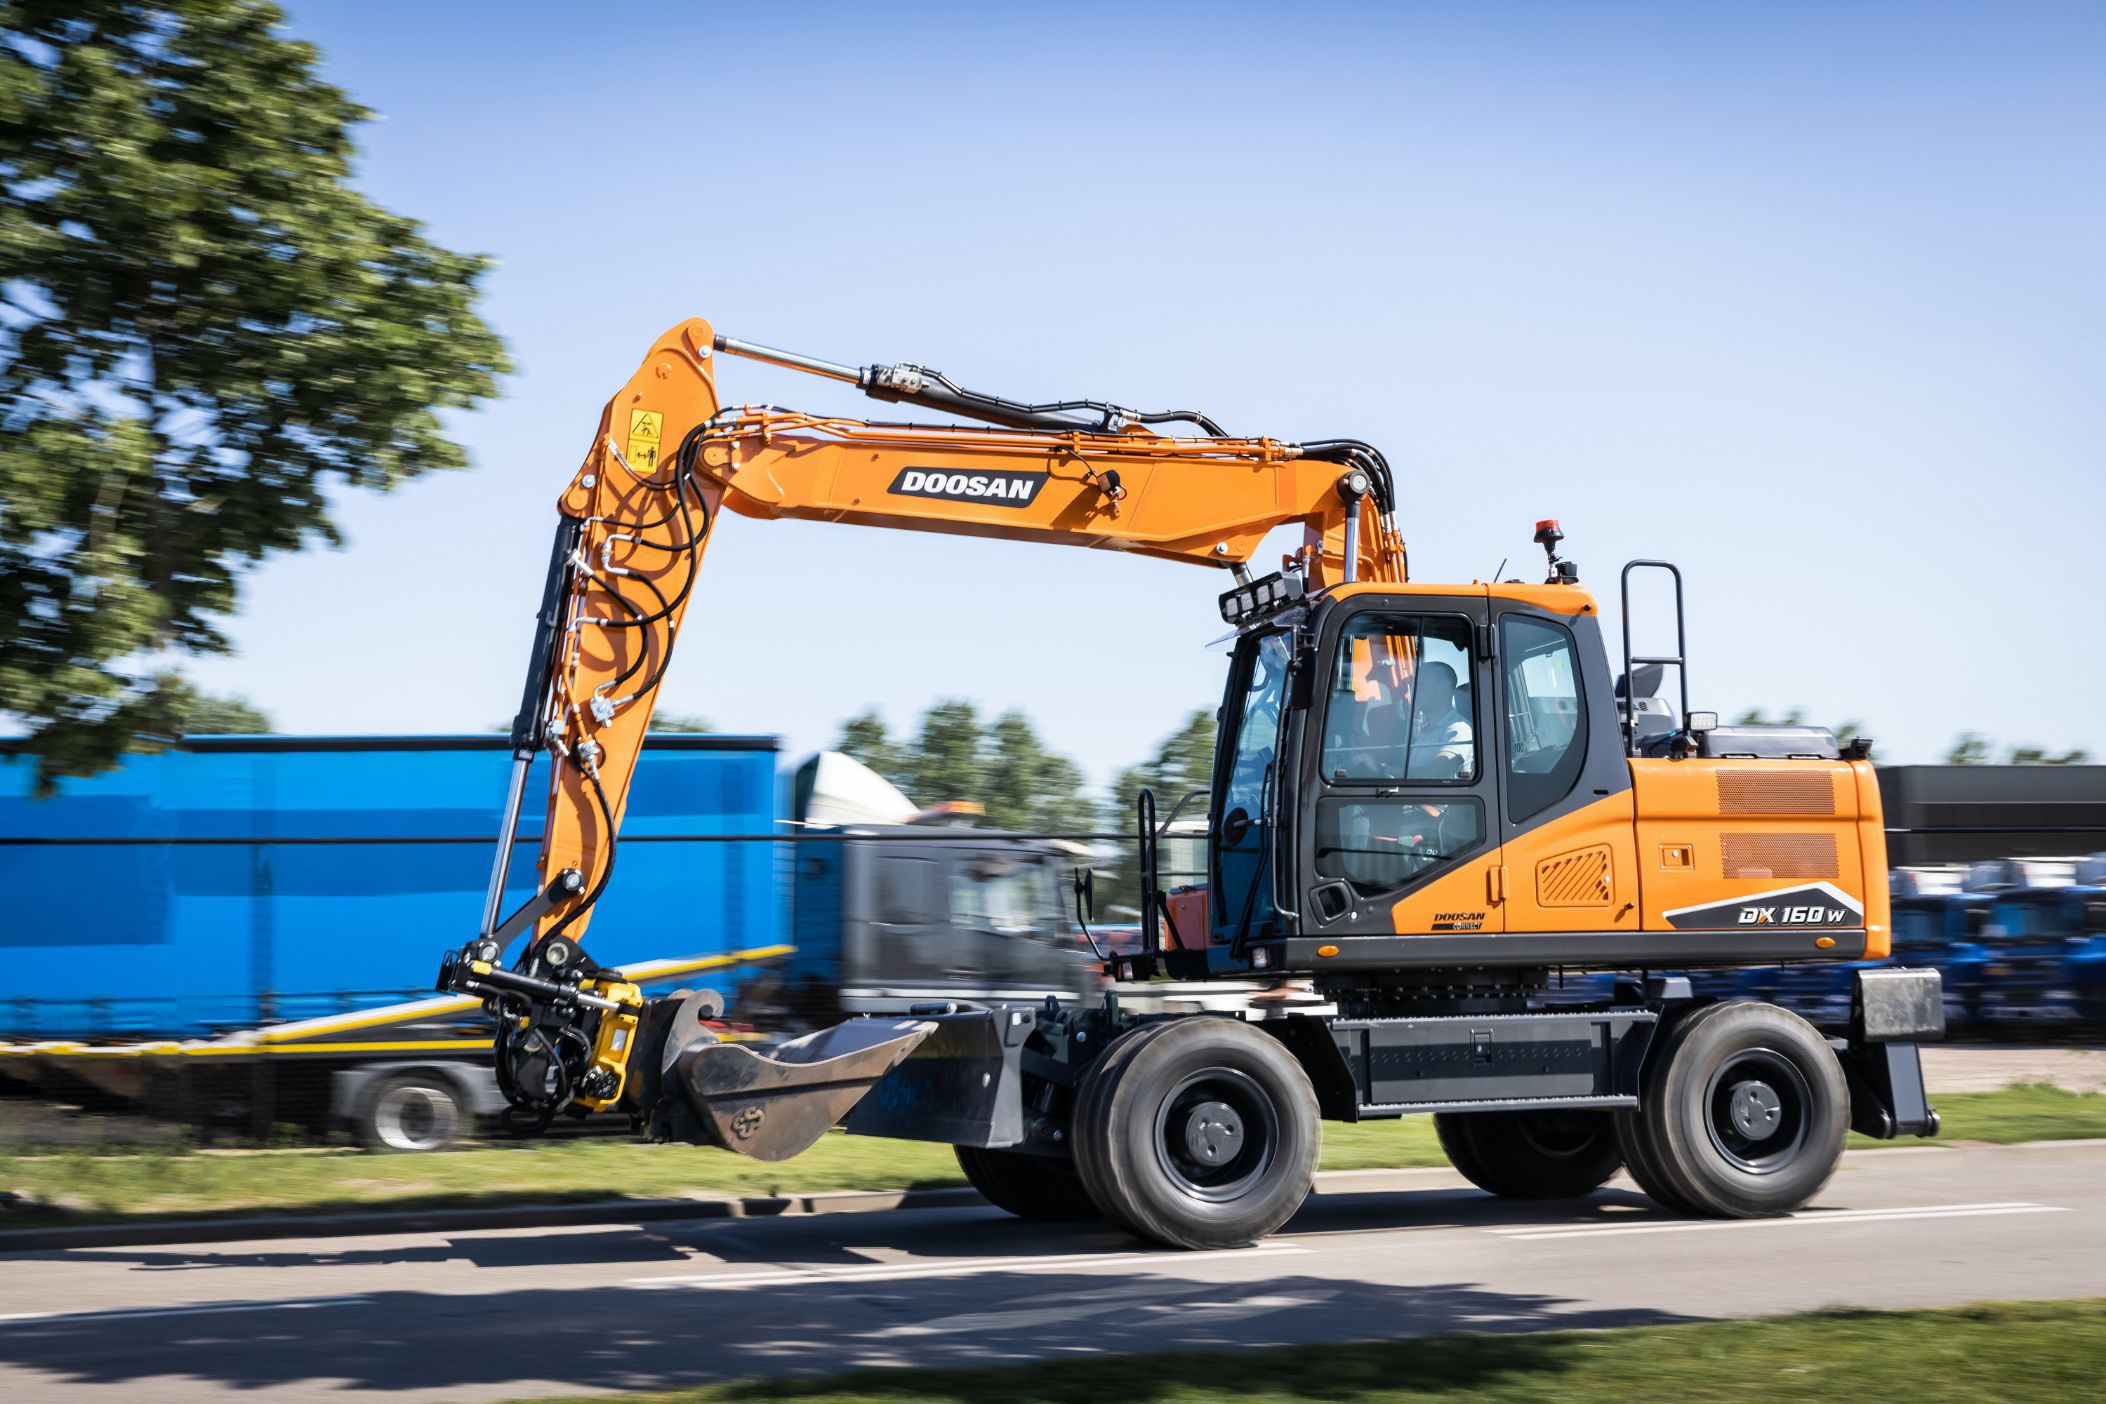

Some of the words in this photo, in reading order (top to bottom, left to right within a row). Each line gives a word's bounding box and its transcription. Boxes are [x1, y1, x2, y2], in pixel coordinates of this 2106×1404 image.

[902, 472, 1034, 499] DOOSAN
[1433, 912, 1485, 921] DOOSAN
[1738, 907, 1775, 924] DX
[1782, 907, 1826, 924] 160
